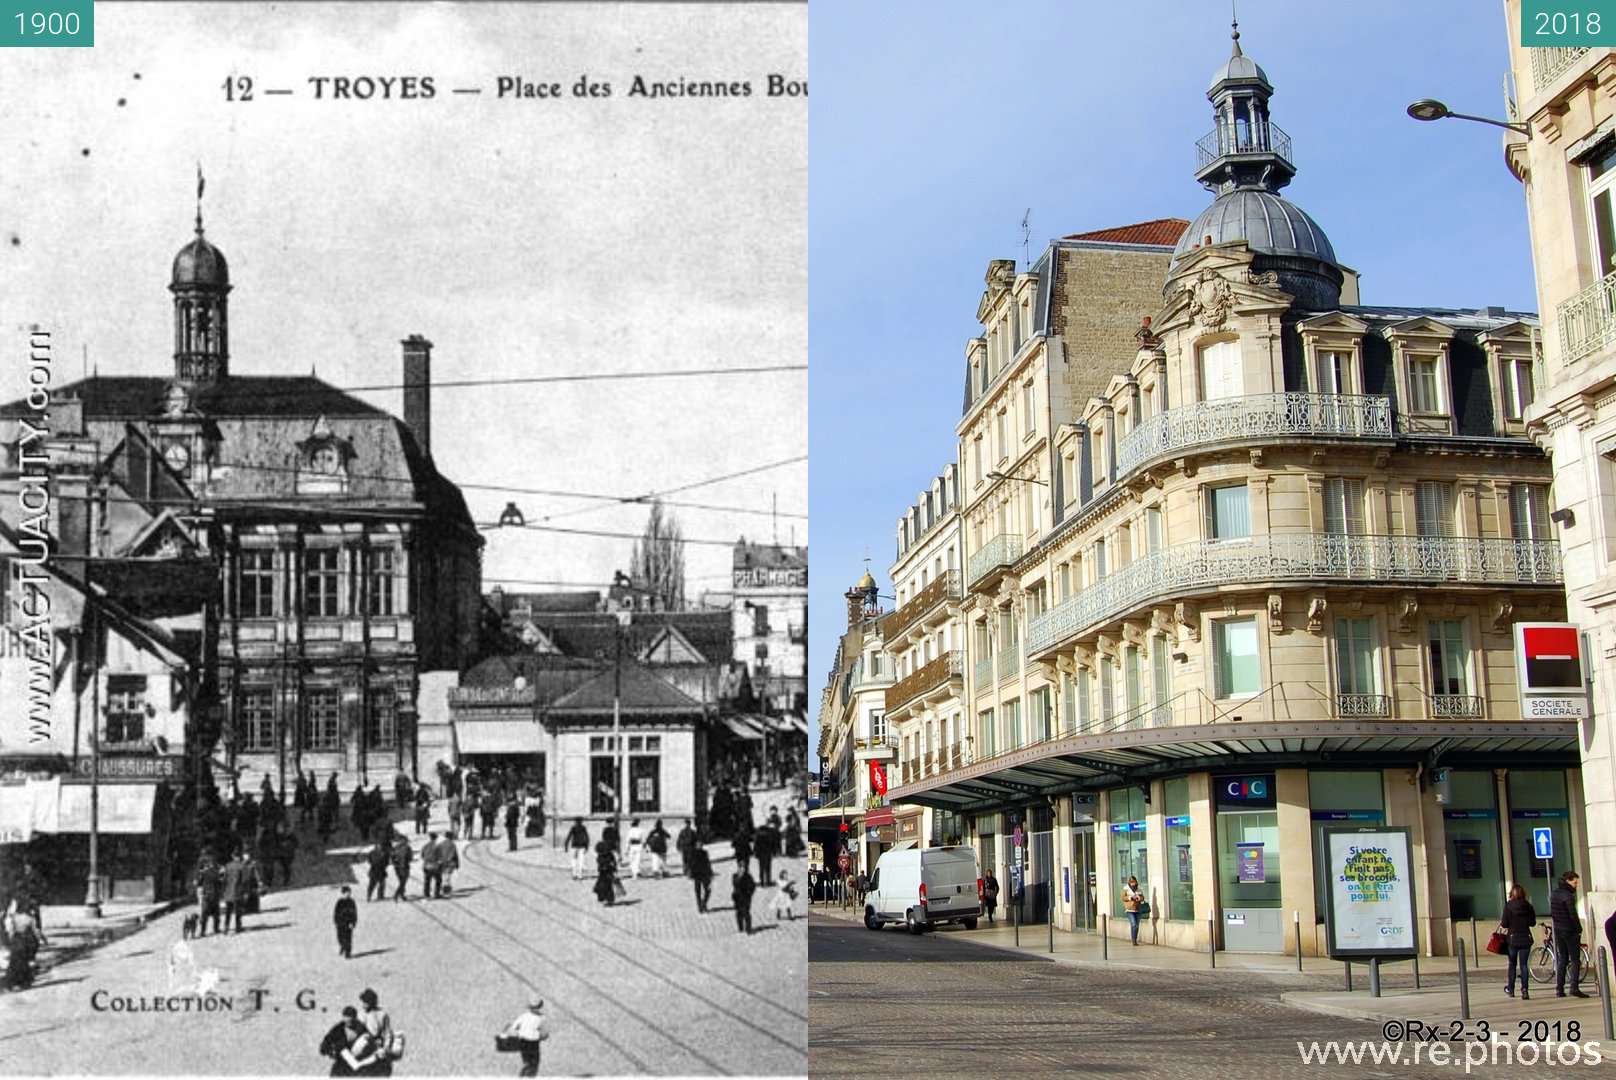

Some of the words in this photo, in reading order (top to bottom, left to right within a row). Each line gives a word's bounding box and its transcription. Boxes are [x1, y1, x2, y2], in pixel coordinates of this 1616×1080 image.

[1227, 780, 1263, 797] CIC
[1349, 846, 1359, 855] Si
[1361, 846, 1388, 855] votre
[1345, 855, 1378, 864] enfant
[1349, 864, 1371, 873] finit
